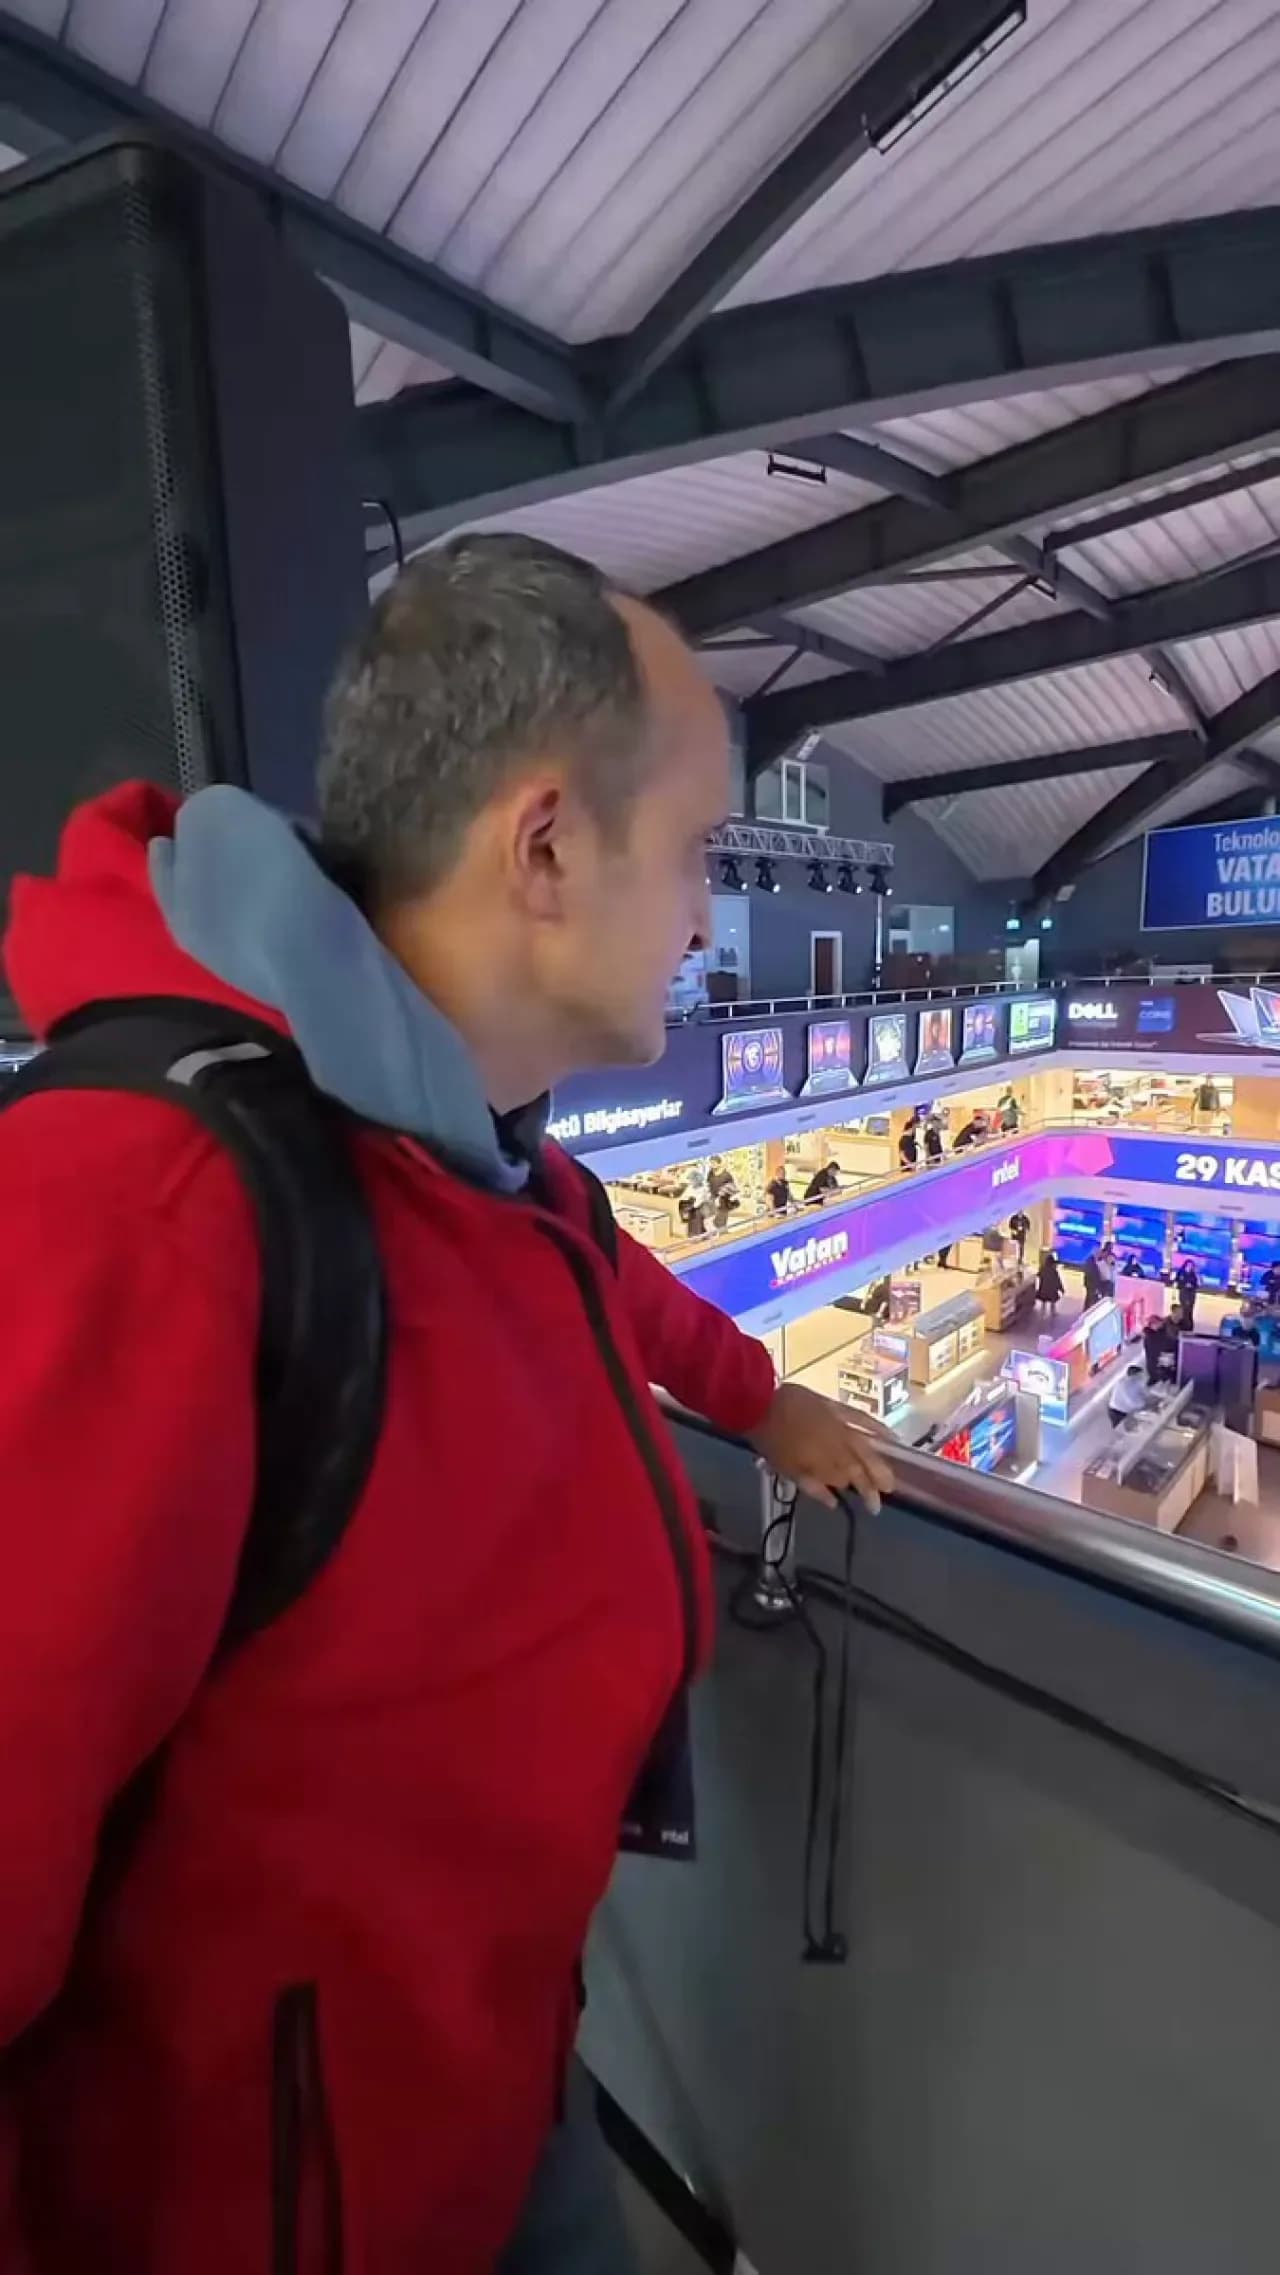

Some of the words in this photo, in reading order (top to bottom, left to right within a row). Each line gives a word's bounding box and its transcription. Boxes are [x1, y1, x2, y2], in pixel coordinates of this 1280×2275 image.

[1068, 1001, 1119, 1019] DELL
[991, 1155, 1020, 1187] intel
[1175, 1153, 1218, 1182] 29
[770, 1231, 849, 1277] Vatan
